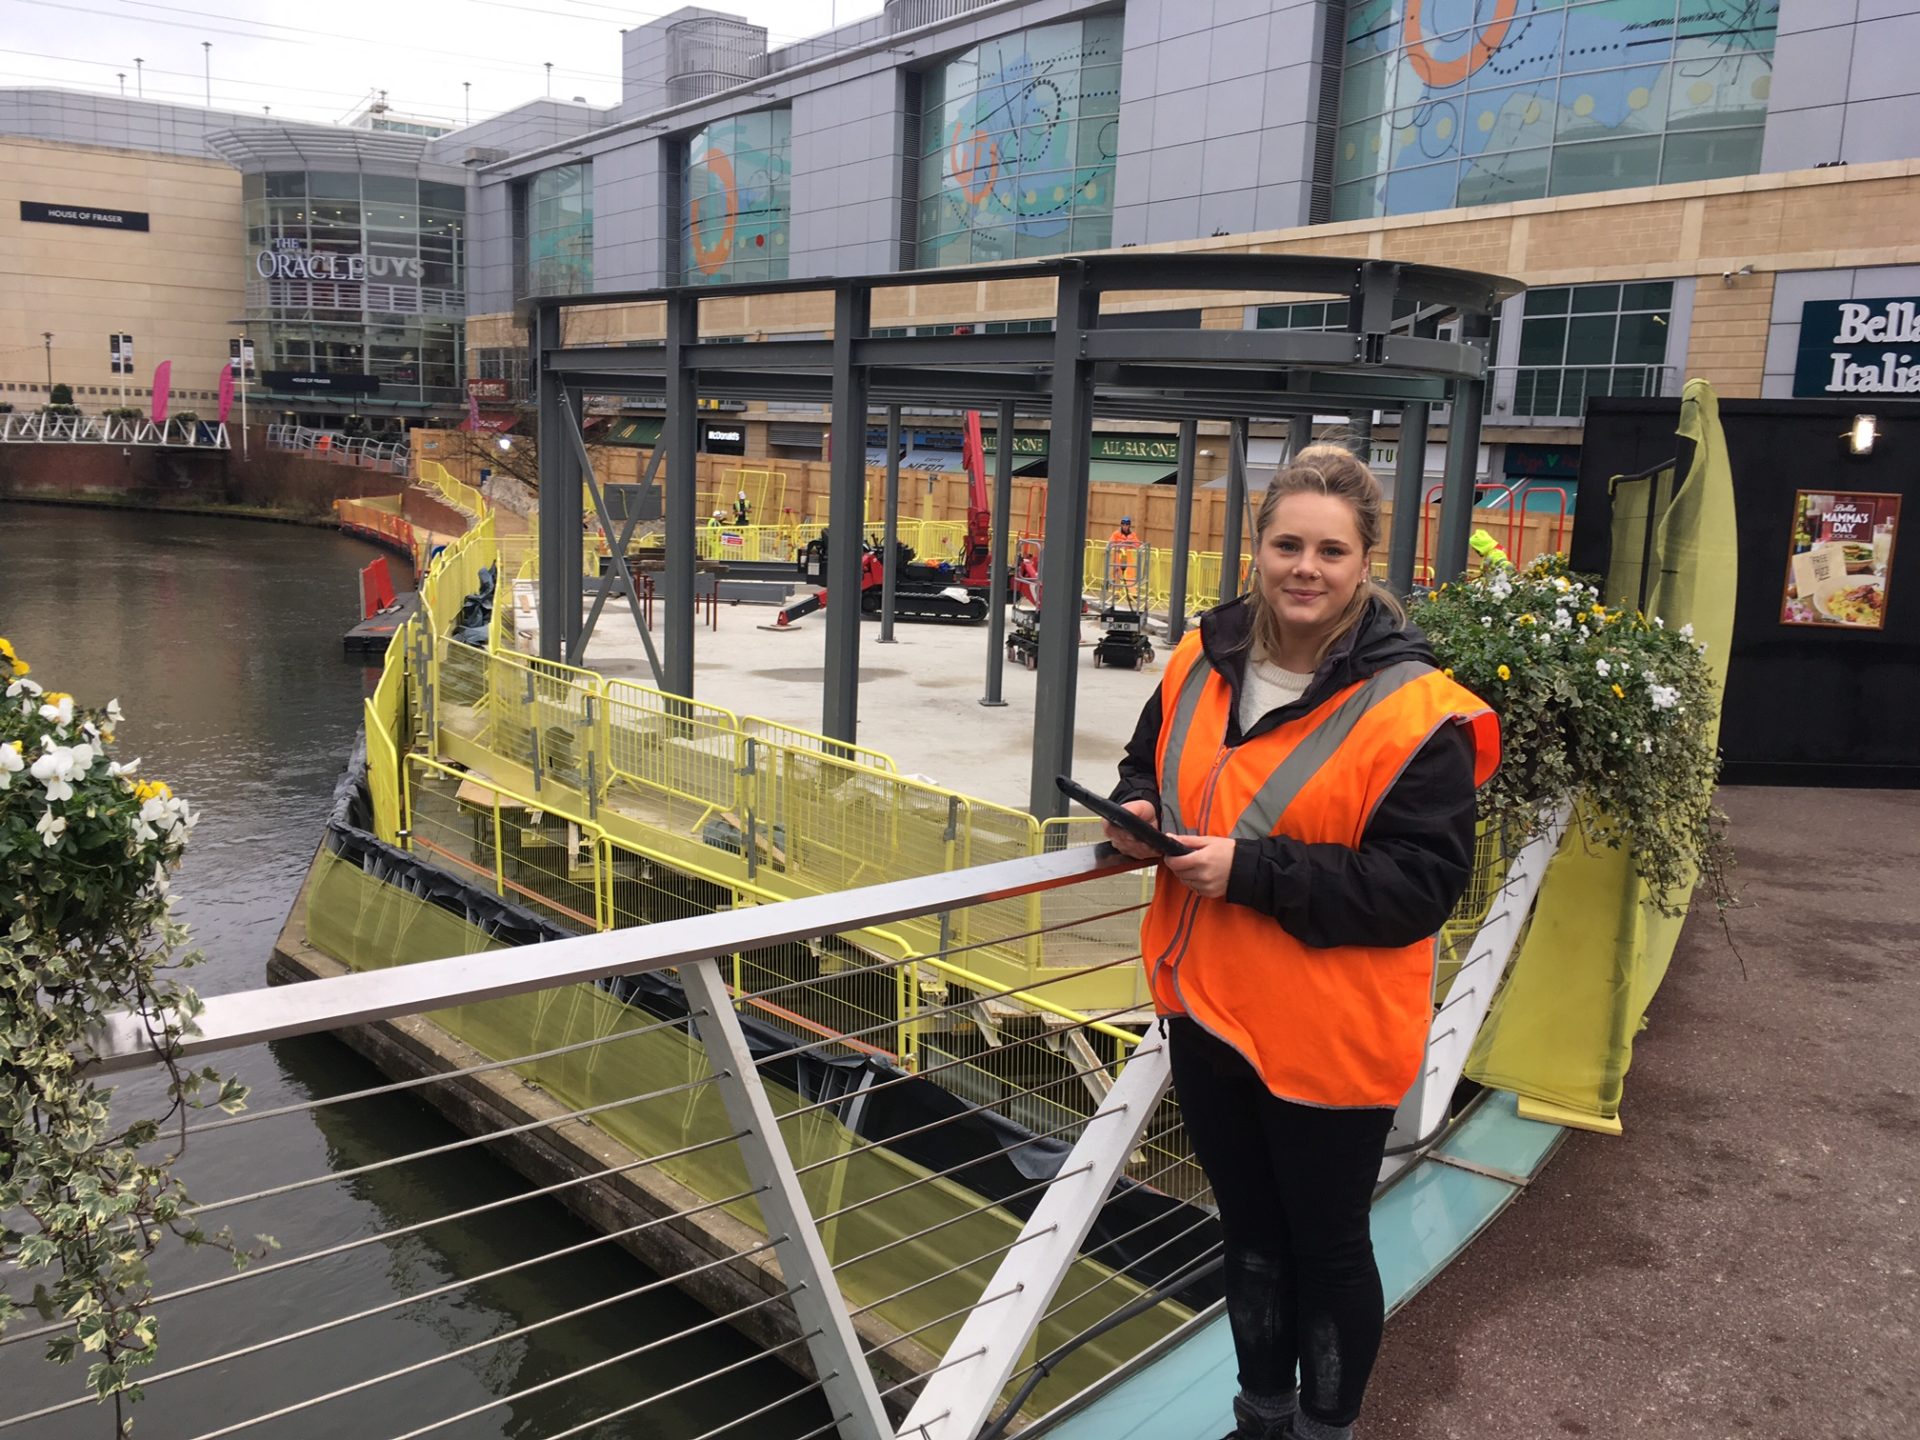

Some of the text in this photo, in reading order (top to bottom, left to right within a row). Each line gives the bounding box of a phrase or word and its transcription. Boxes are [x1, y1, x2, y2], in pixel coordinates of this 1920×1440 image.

[48, 210, 123, 223] HOUSE OF FRASER
[275, 238, 299, 249] THE
[257, 250, 366, 281] ORACLE
[354, 253, 425, 279] UYS
[1021, 438, 1043, 452] ONE
[1150, 443, 1177, 457] ONE
[1367, 448, 1399, 462] TTU
[1822, 512, 1869, 524] MAMMA'S
[1832, 522, 1857, 533] DAY
